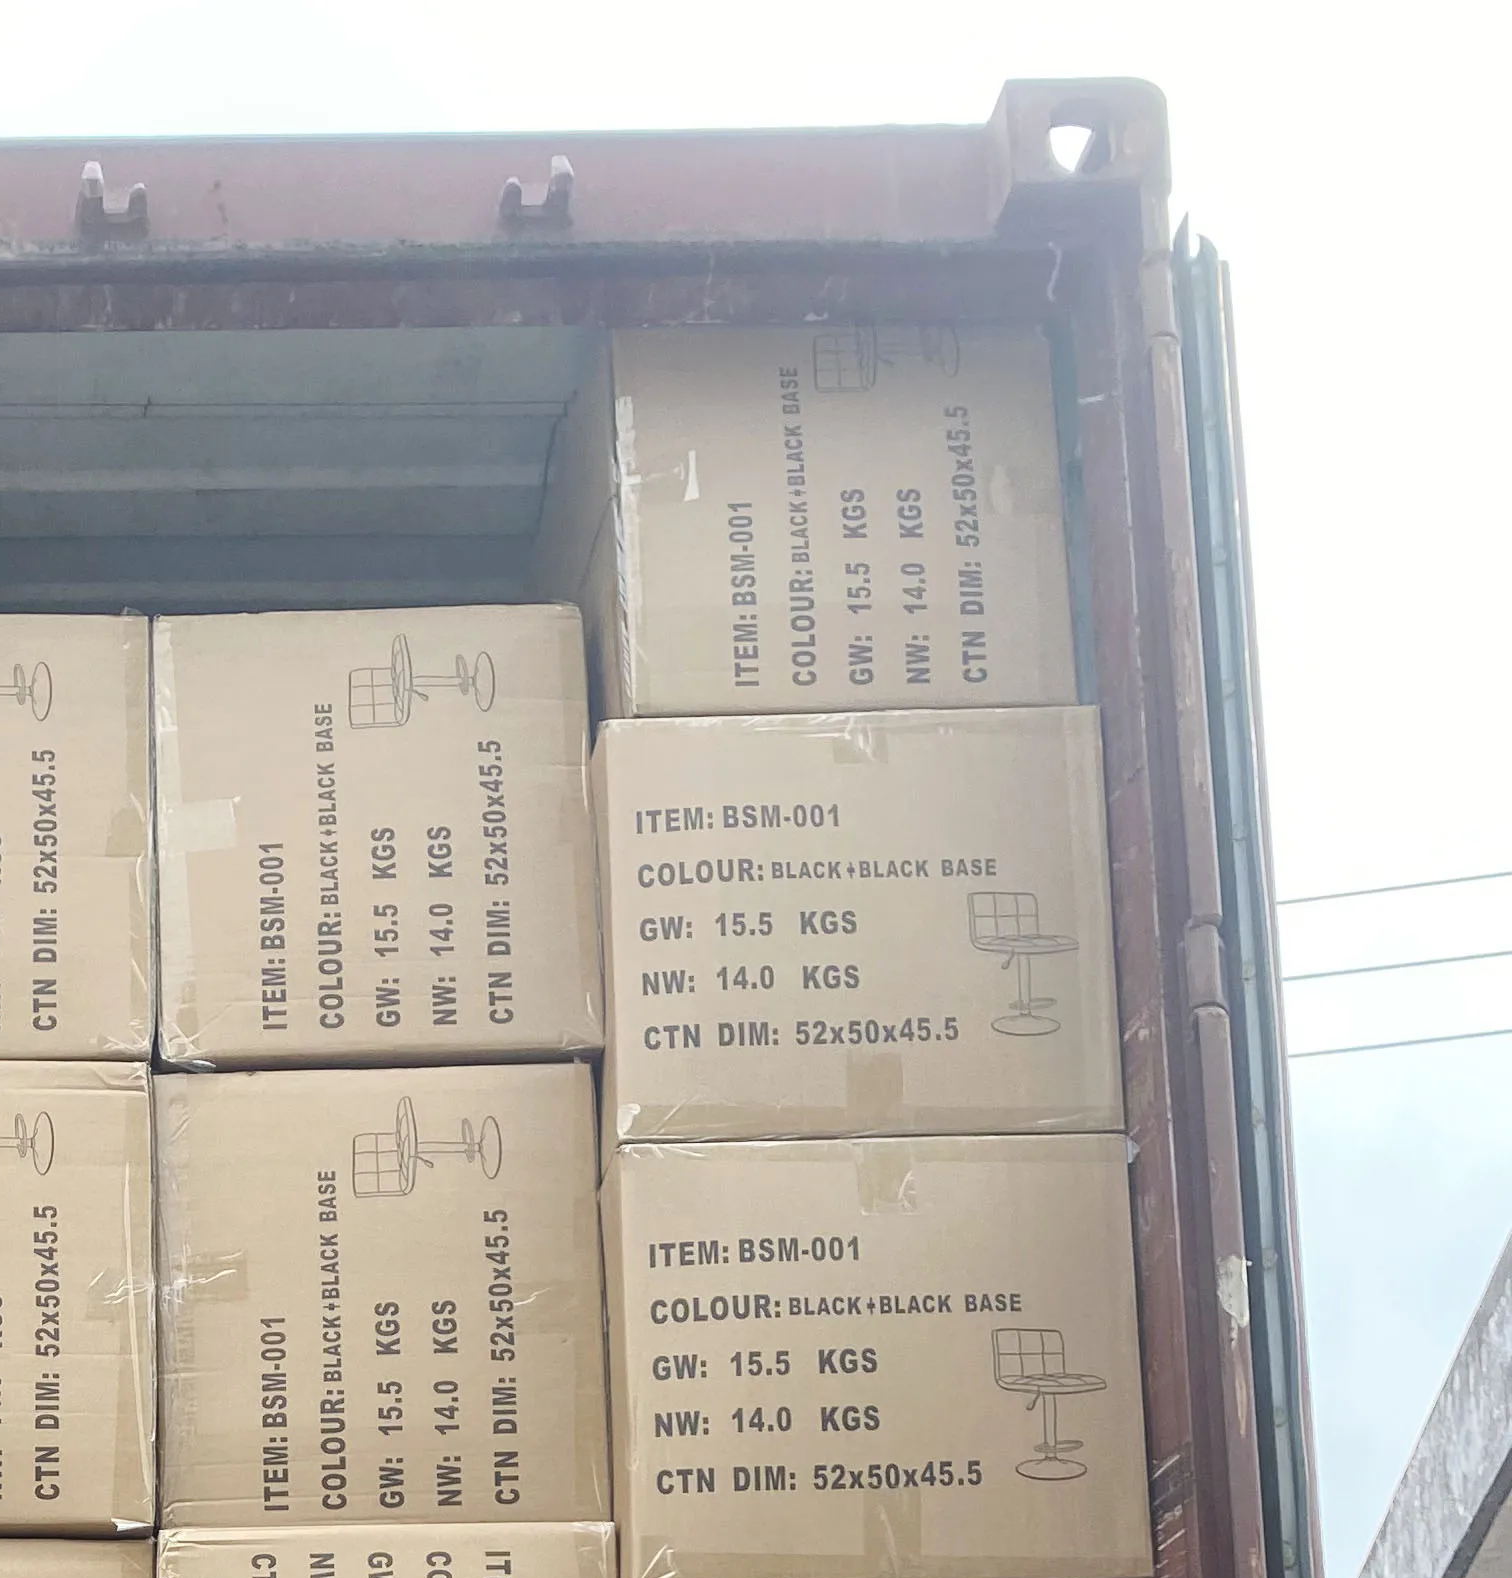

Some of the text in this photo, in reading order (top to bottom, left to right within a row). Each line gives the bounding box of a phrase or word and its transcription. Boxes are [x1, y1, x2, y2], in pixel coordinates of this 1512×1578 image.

[895, 488, 931, 684] NW: 14.0 KGS
[944, 405, 988, 683] CTN DIM: 52x50x45.5
[31, 749, 58, 1031] CTN DIM: 52x50x45.5
[426, 825, 457, 1025] NW: 14.0 KGS
[476, 739, 514, 1024] CTN DIM: 52x50x45.5
[639, 909, 857, 942] GW: 15.5 KGS
[643, 1016, 959, 1050] CTN DIM: 52x50x45.5
[33, 1204, 61, 1500] CTN DIM: 52x50x45.5
[373, 1300, 405, 1508] GW: 15.5 KGS
[483, 1208, 520, 1504] CTN DIM: 52x50x45.5
[654, 1404, 880, 1438] NW: 14.0 KGS
[656, 1460, 982, 1495] CTN DIM: 52x50x45.5
